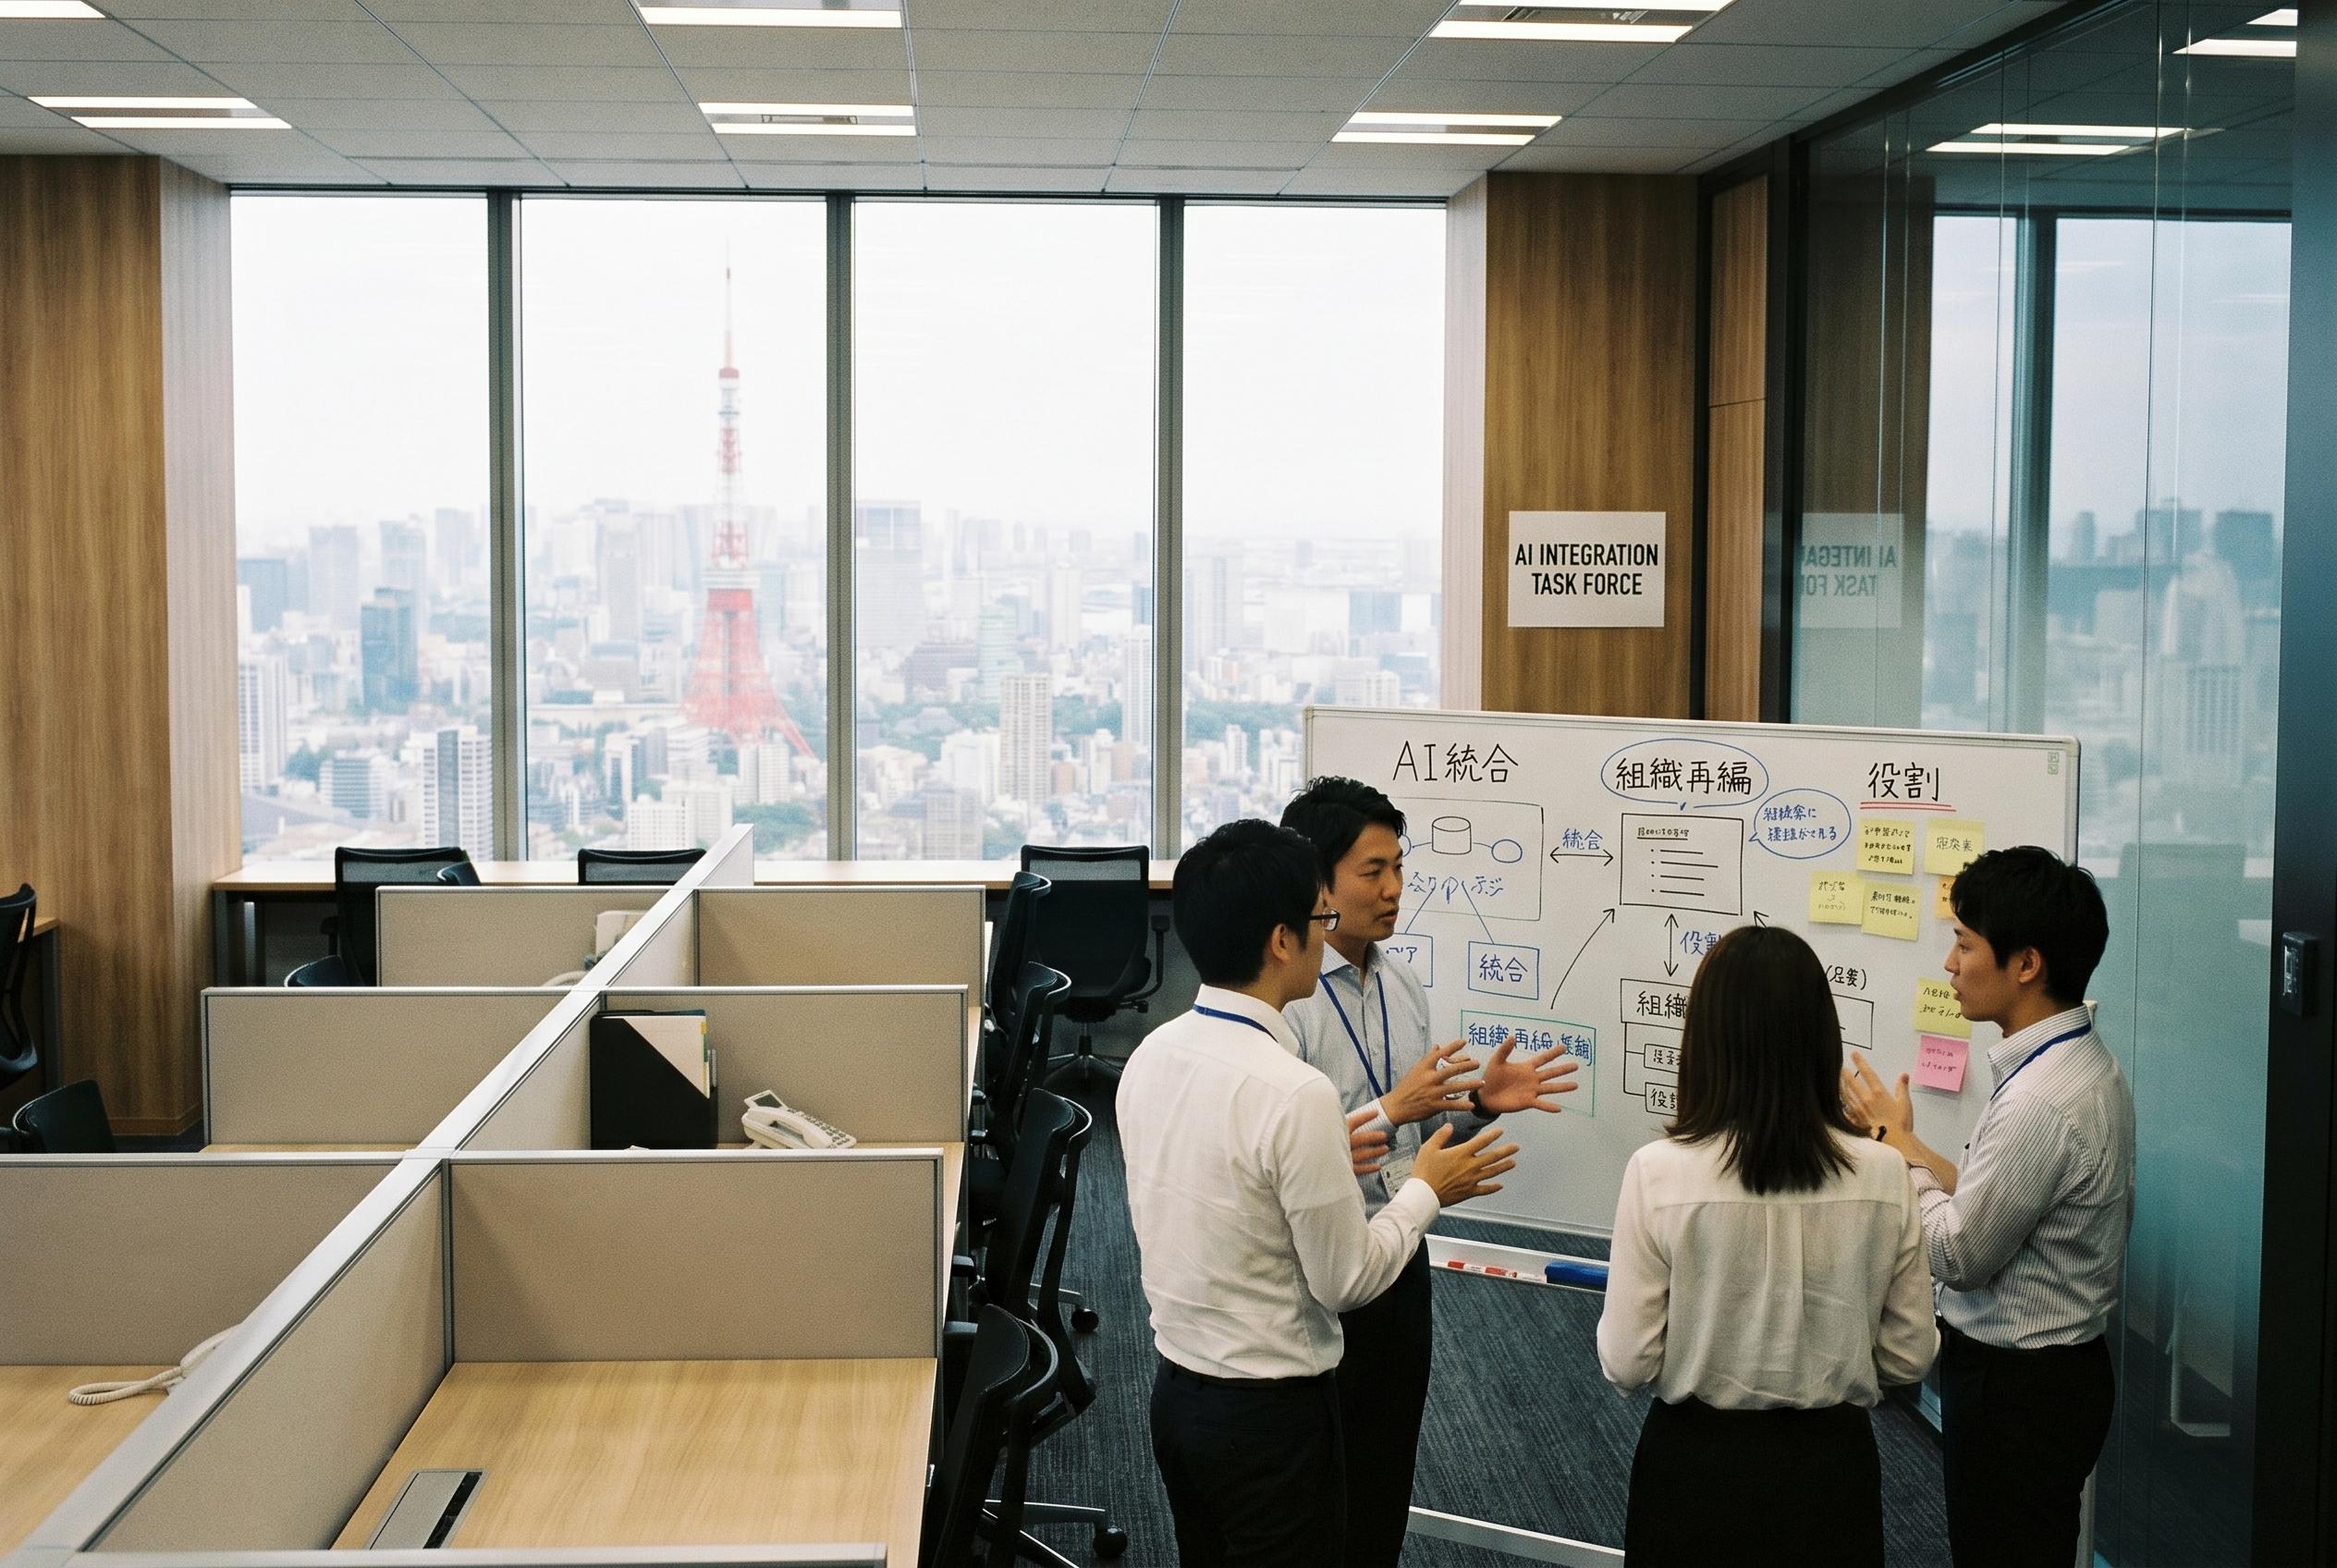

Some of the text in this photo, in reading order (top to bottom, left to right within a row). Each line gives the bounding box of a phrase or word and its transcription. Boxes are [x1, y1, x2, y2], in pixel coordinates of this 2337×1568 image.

[1515, 544, 1658, 566] AI INTEGRATION
[1532, 572, 1643, 594] TASK FORCE
[1392, 740, 1519, 783] AI統合
[1615, 757, 1752, 795] 組織再編
[1866, 762, 1940, 802] 役割
[1479, 952, 1528, 983] 統合
